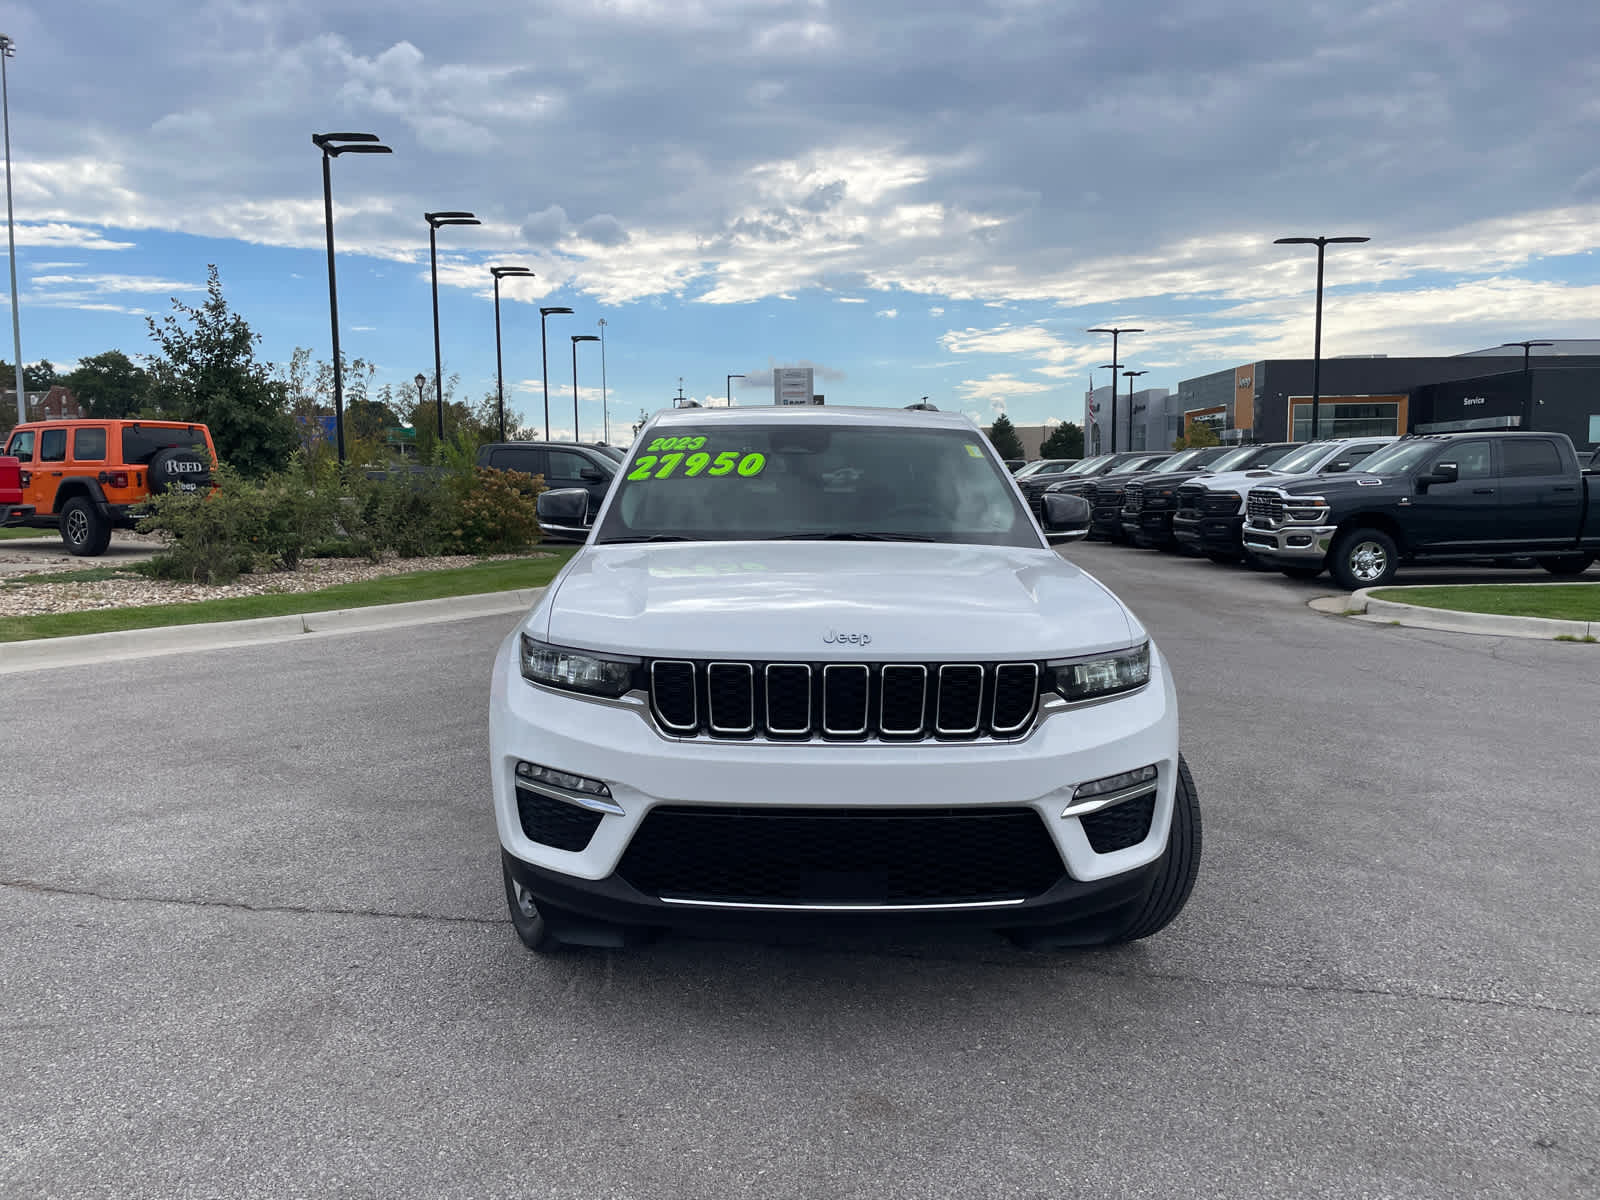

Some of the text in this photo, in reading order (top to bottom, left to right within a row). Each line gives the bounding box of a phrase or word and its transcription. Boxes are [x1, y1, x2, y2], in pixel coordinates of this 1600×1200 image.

[1463, 396, 1485, 406] Service
[646, 436, 708, 452] 2023
[165, 459, 202, 475] REED
[626, 451, 767, 481] 27950
[823, 629, 872, 646] Jeep
